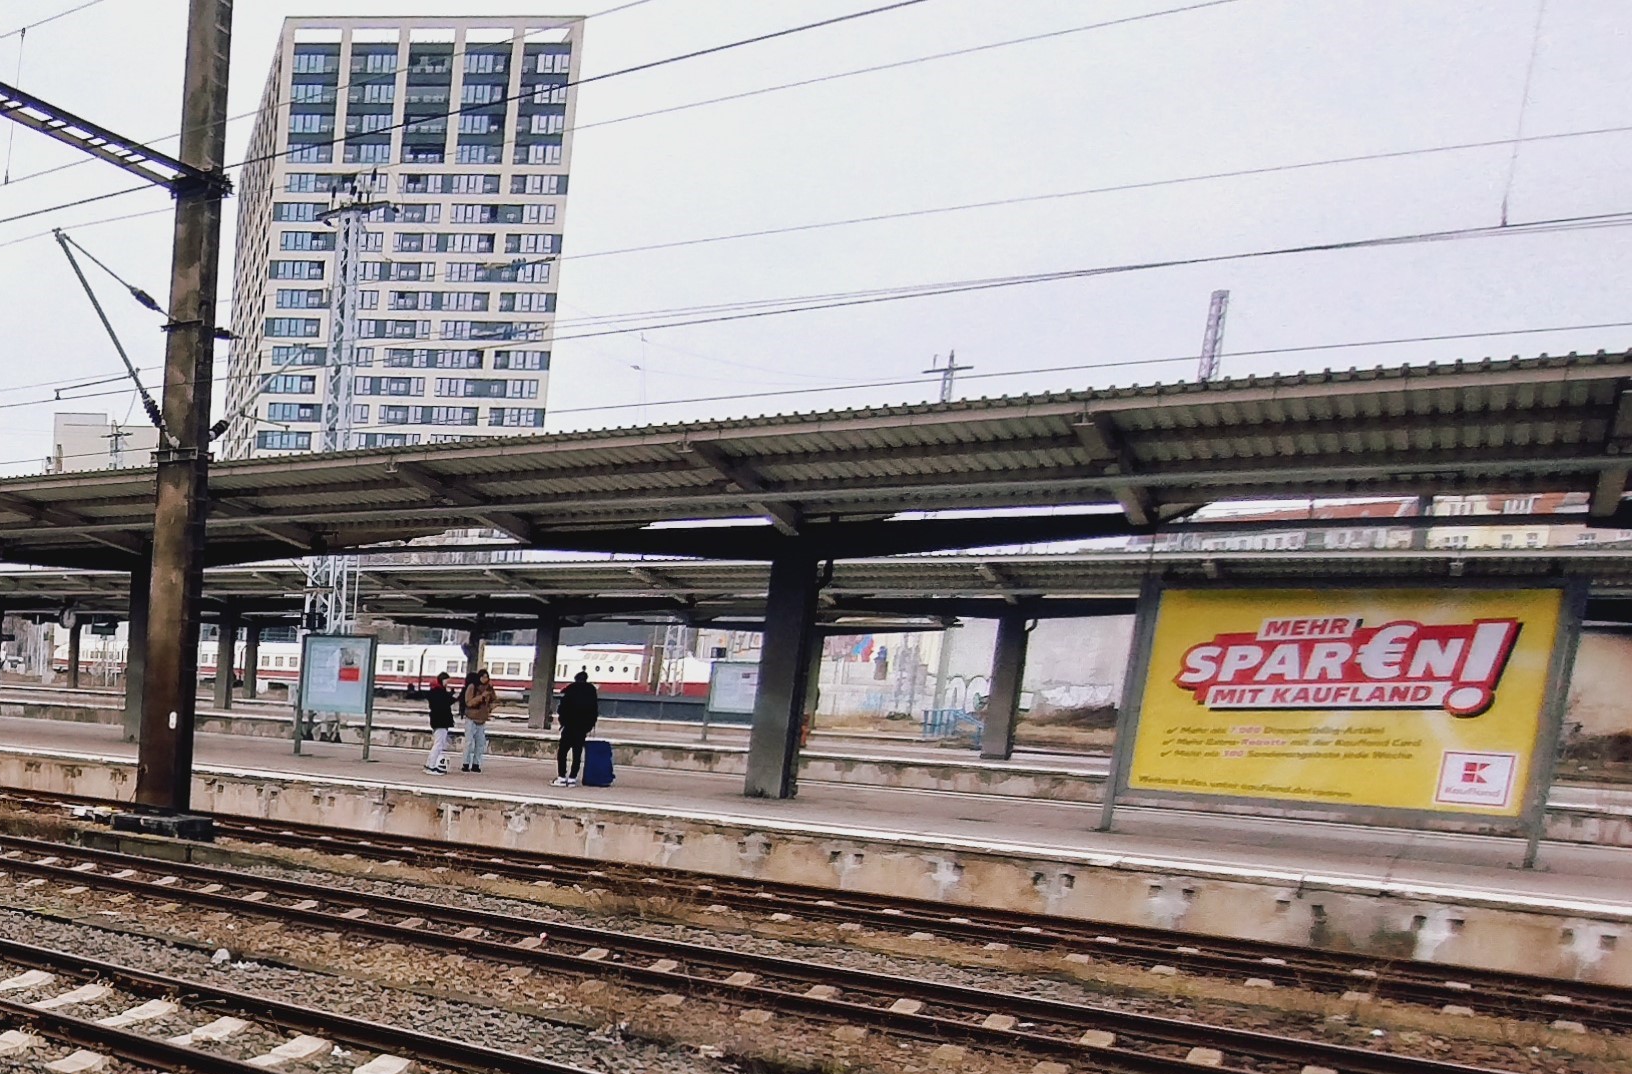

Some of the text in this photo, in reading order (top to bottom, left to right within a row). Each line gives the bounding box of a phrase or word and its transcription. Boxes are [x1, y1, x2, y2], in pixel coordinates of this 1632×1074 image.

[1265, 618, 1349, 638] MEHR
[1212, 685, 1433, 705] MIT KAUFLAND
